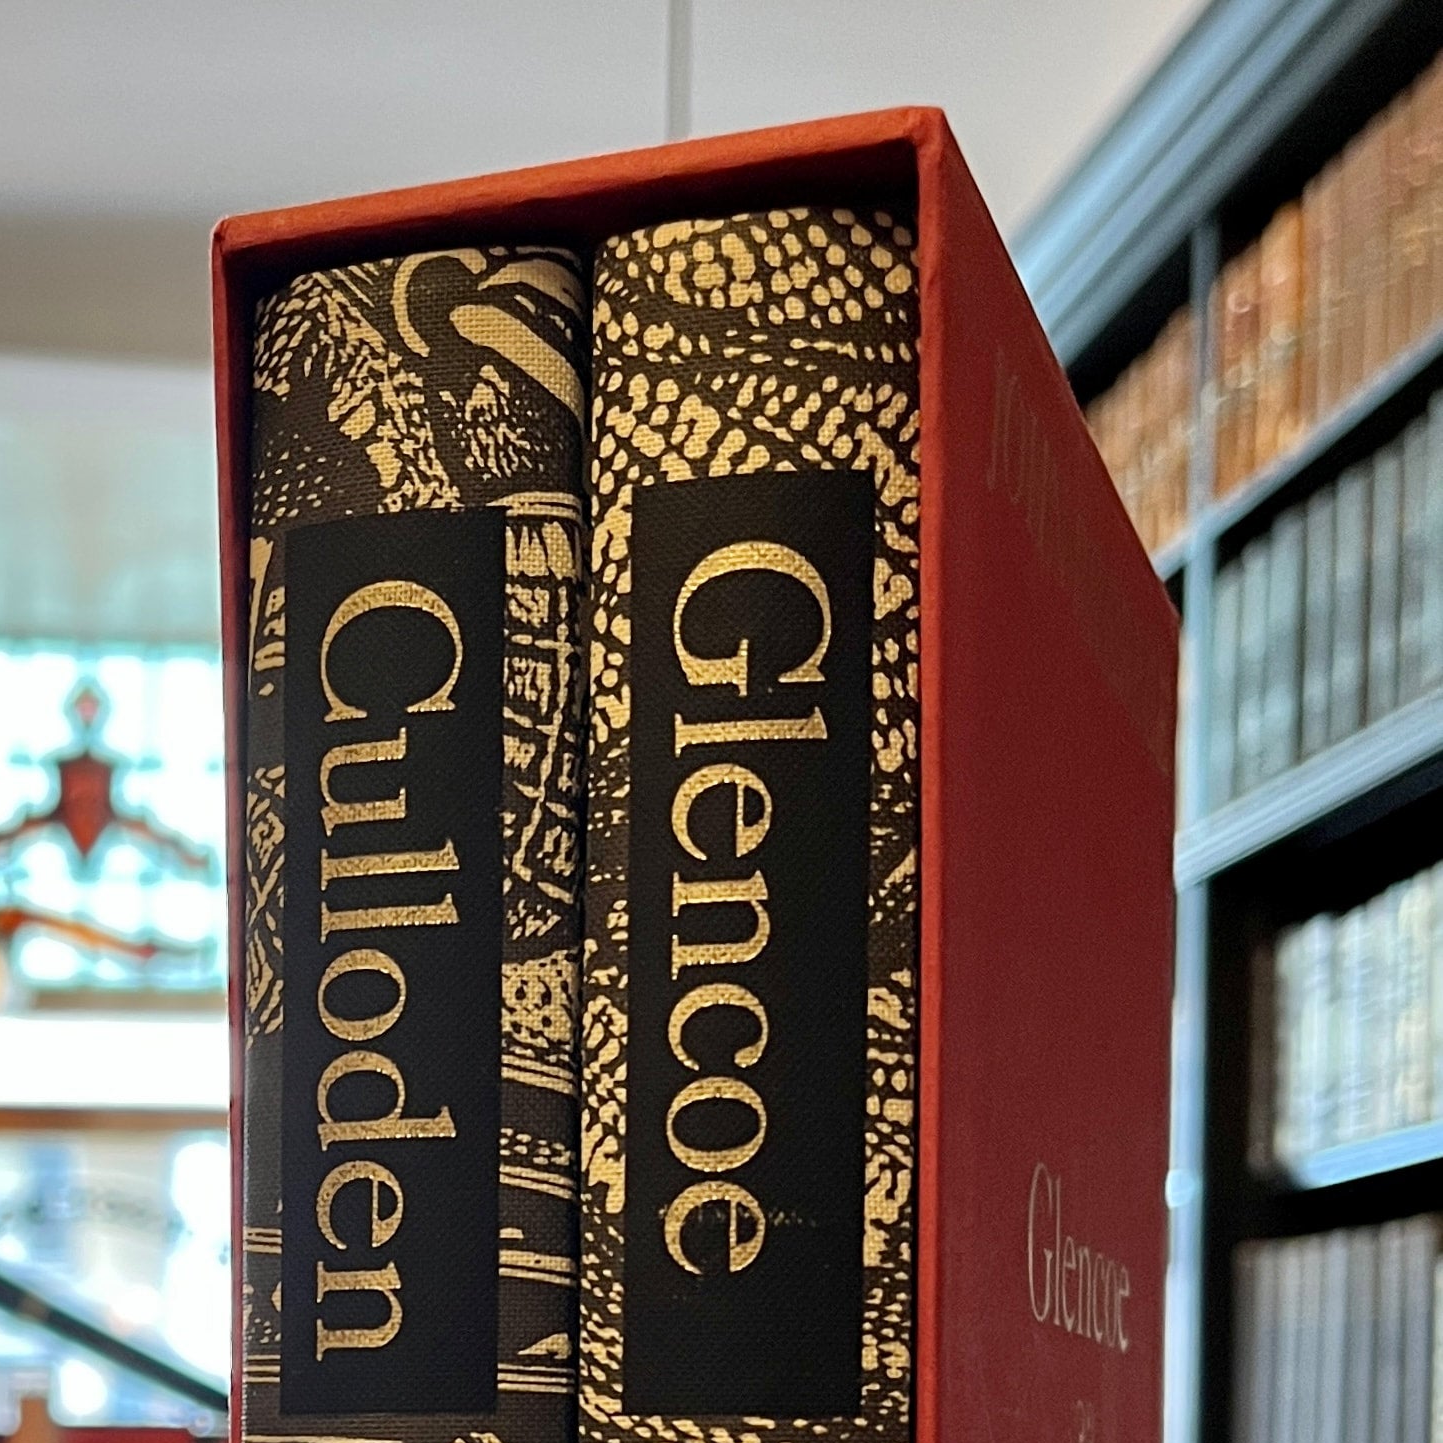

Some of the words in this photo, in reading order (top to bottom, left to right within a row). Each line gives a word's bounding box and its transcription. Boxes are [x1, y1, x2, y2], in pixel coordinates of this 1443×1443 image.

[315, 578, 467, 1362] Culloden
[664, 540, 833, 1277] Glencoe
[1027, 1161, 1131, 1354] Glencoe
